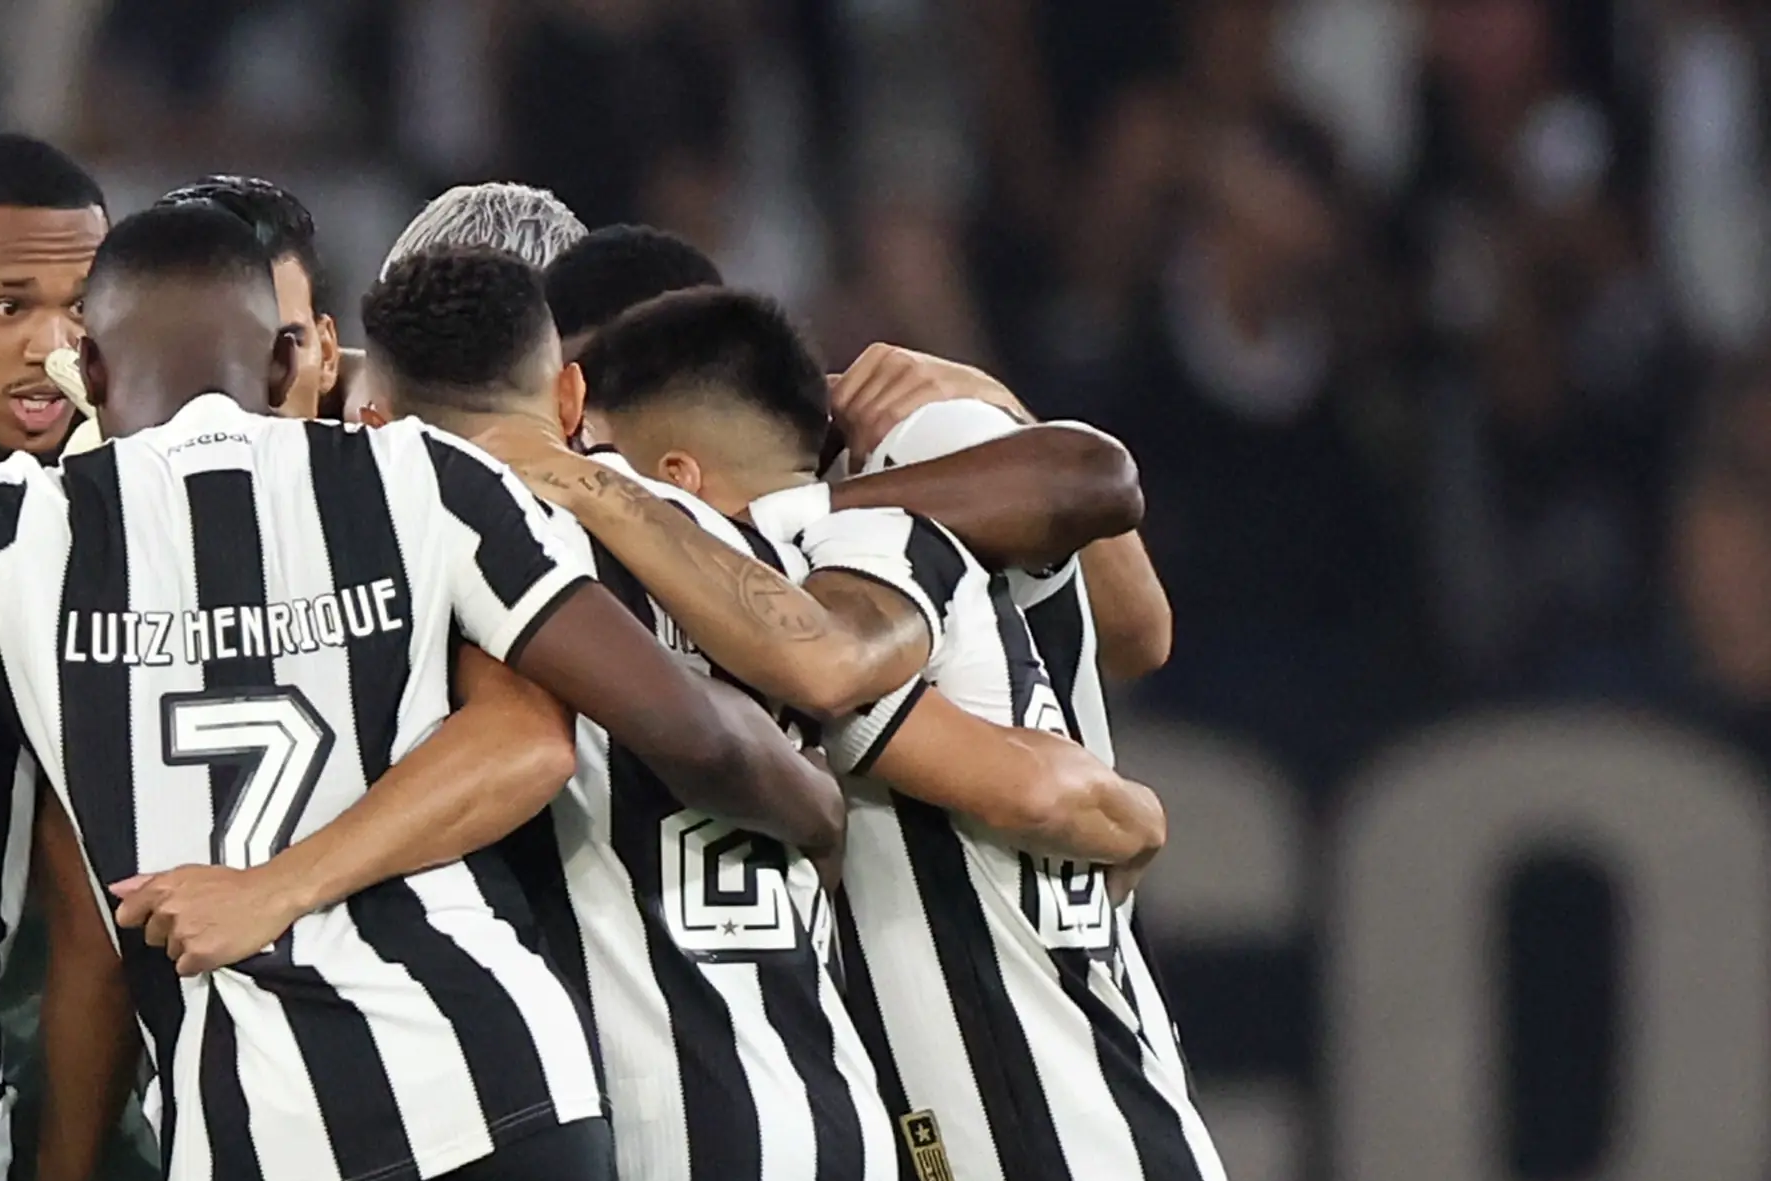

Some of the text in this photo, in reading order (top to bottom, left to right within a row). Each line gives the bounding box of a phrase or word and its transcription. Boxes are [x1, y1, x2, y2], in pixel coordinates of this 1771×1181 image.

[64, 577, 404, 667] LUIZ HENRIQUE
[168, 694, 328, 872] 7
